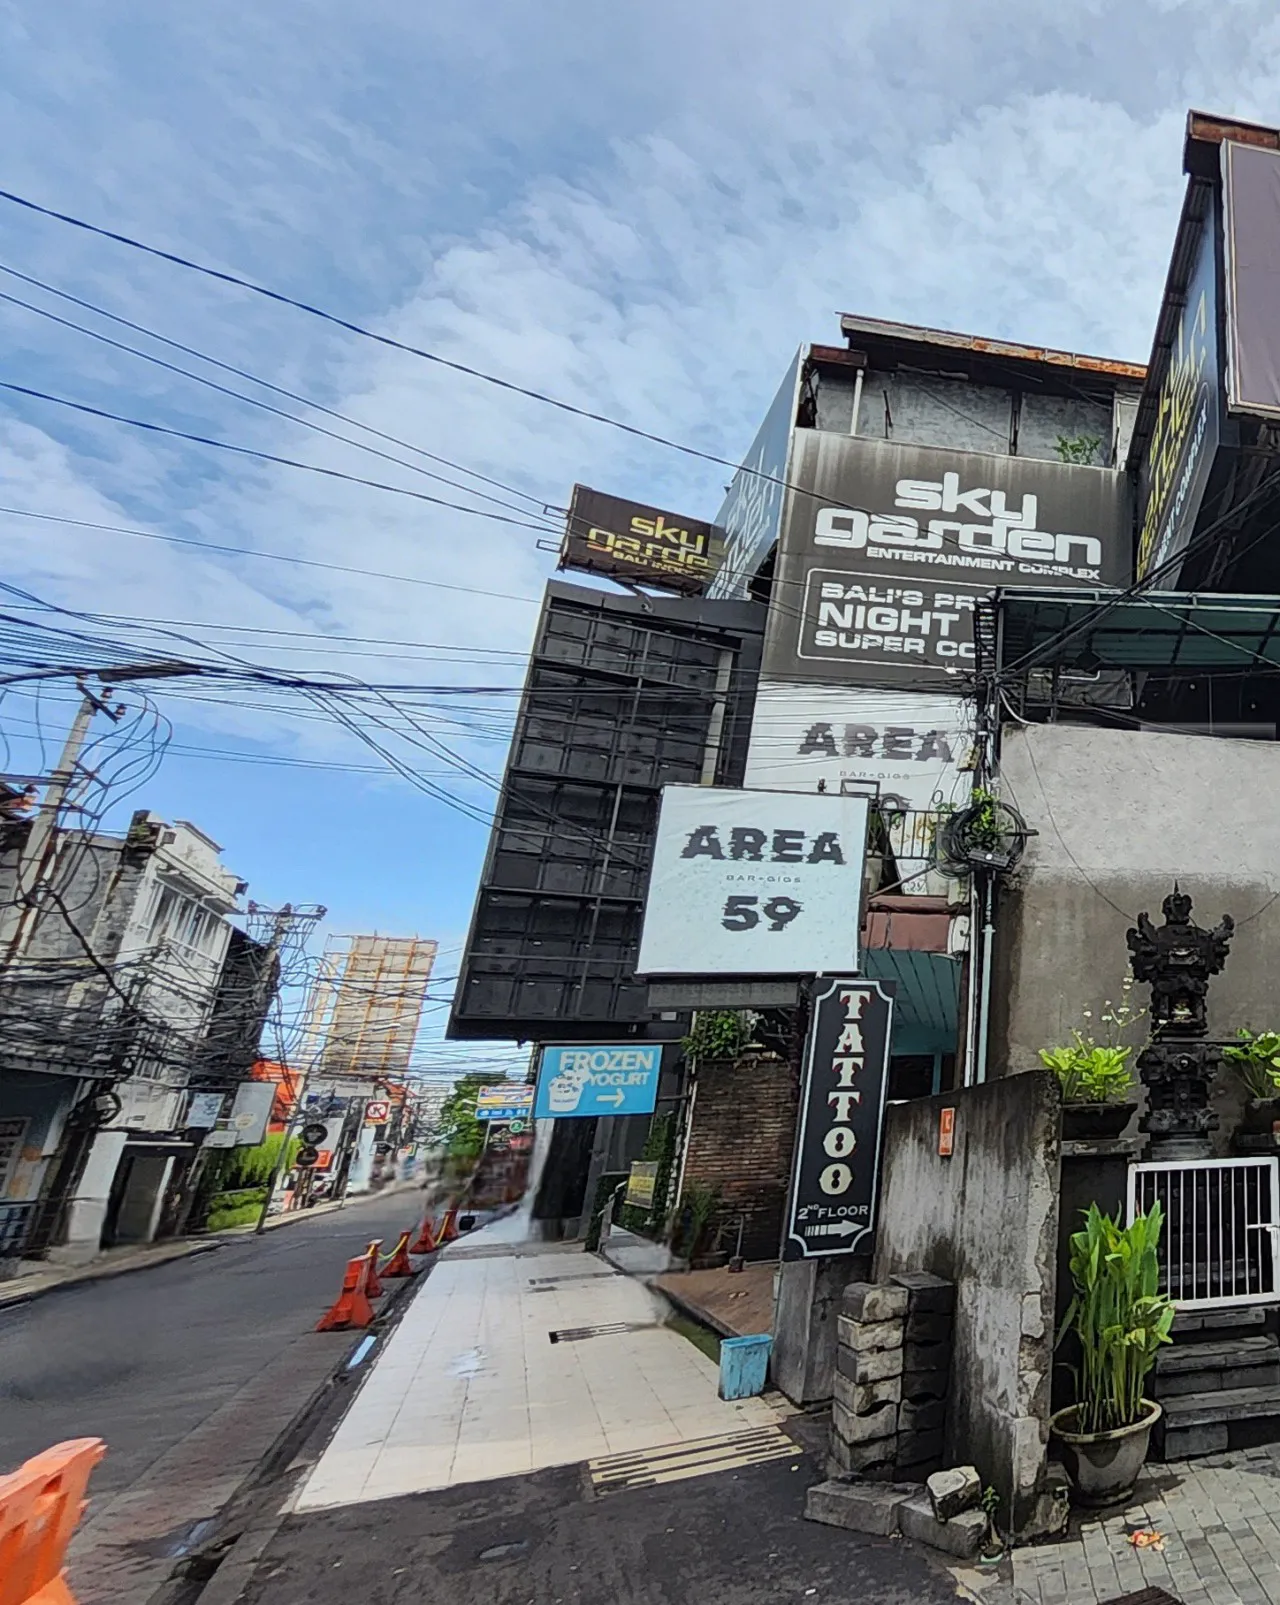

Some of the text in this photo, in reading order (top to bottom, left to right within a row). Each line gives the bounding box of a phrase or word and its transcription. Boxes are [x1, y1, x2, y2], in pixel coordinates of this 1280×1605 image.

[894, 471, 1038, 530] sky
[630, 516, 705, 554] sky
[814, 507, 1102, 565] garden
[866, 546, 1101, 581] ENTERTAINMENT COMPLEX
[821, 582, 924, 606] BALI'S
[817, 601, 960, 636] NIGHT
[814, 630, 926, 654] SUPER
[797, 722, 955, 763] AREA
[679, 825, 848, 866] AREA
[720, 895, 806, 932] 59
[560, 1050, 655, 1071] FROZEN
[589, 1072, 651, 1087] YOGURT
[818, 990, 871, 1195] TATTOO
[818, 1205, 869, 1219] FLOOR
